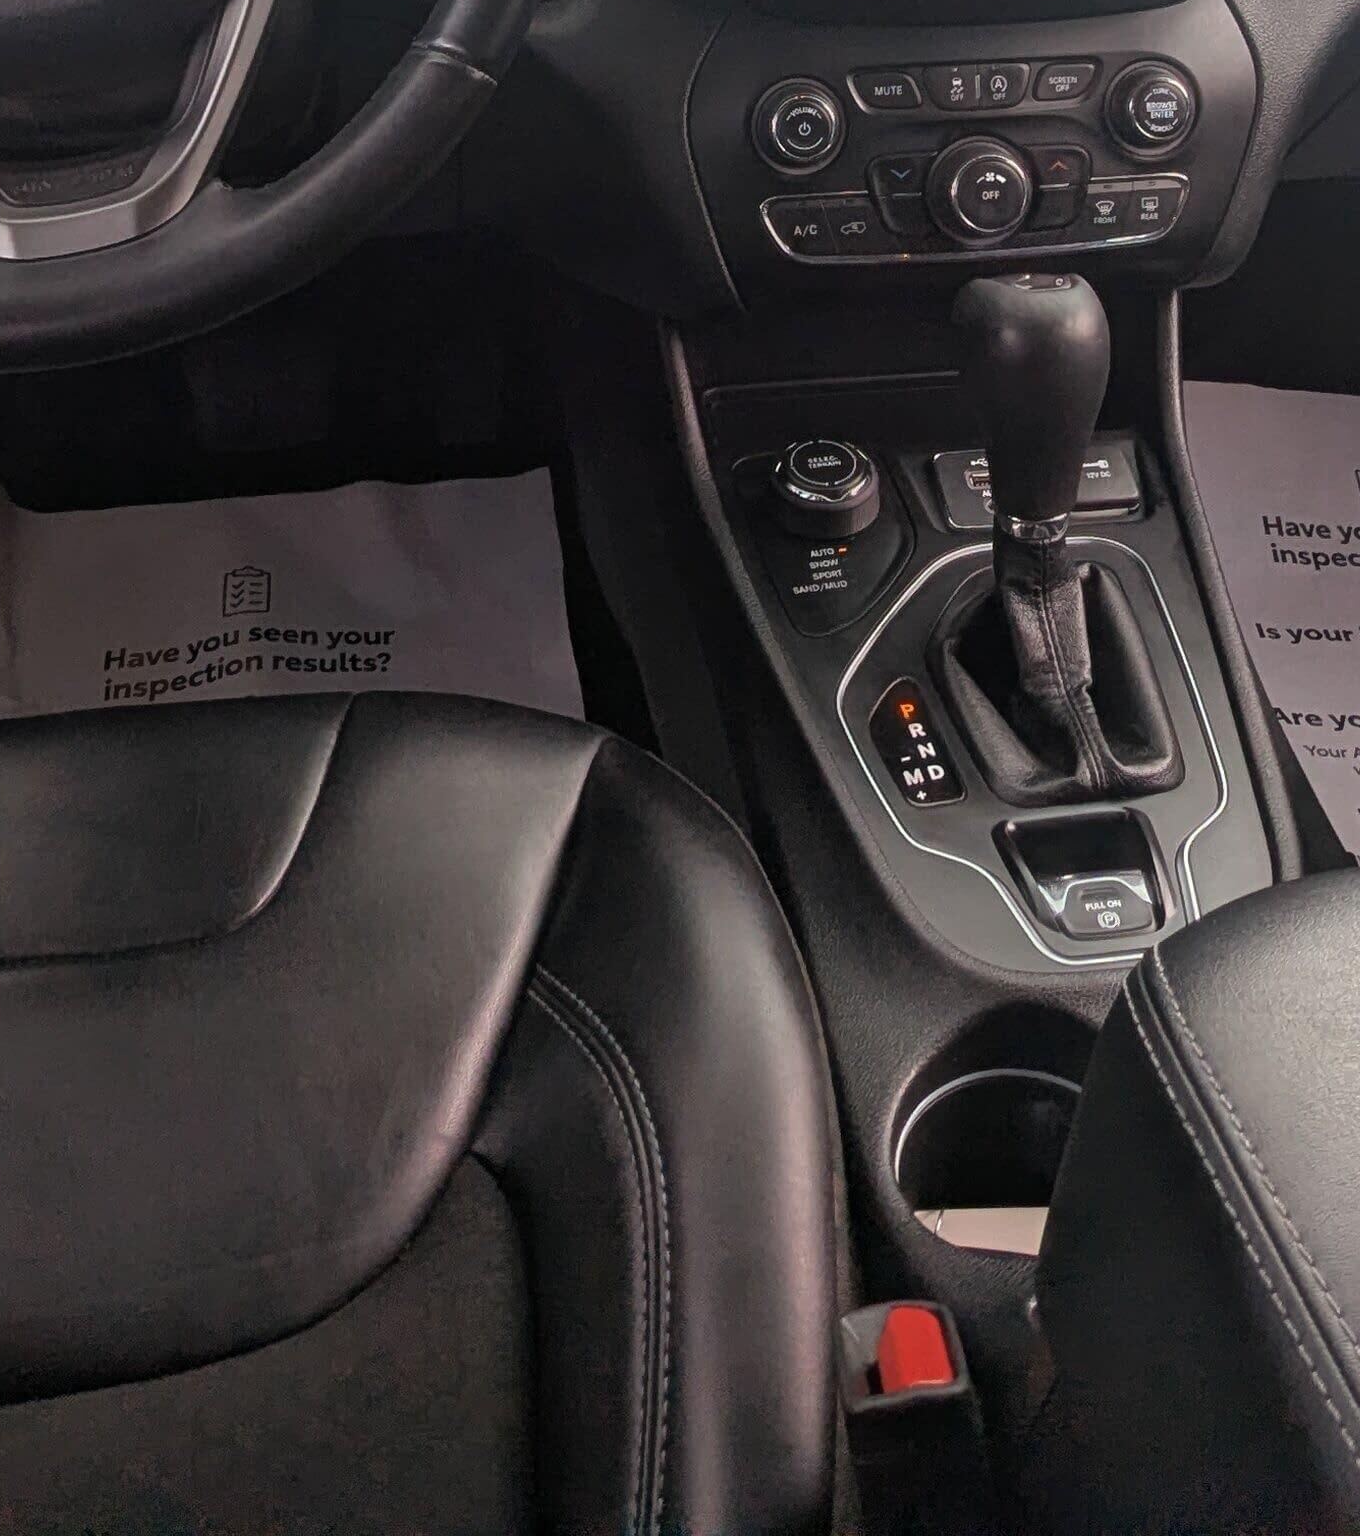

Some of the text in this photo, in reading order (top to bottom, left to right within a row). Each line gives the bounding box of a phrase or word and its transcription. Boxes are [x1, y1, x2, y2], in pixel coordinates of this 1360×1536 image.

[1049, 76, 1077, 85] SCREEN
[874, 85, 903, 96] MUTE
[1056, 83, 1071, 92] OFF
[993, 92, 1006, 101] OFF
[1146, 101, 1177, 112] BROWSE
[982, 191, 1000, 200] OFF
[794, 224, 817, 236] A/C
[1262, 515, 1331, 539] Have
[810, 548, 835, 558] AUTO
[809, 558, 839, 570] SNOW
[812, 569, 842, 580] SPORT
[792, 580, 848, 595] SAND/MUD
[1255, 623, 1281, 640] Is
[1287, 627, 1353, 644] your
[103, 625, 395, 672] Have you seen your
[103, 652, 391, 702] inspection results?
[900, 704, 914, 719] P
[1272, 707, 1323, 726] Are
[908, 723, 926, 738] R
[917, 742, 936, 759] N
[1303, 745, 1347, 758] Your
[903, 765, 945, 786] M D
[1085, 902, 1106, 912] PULL
